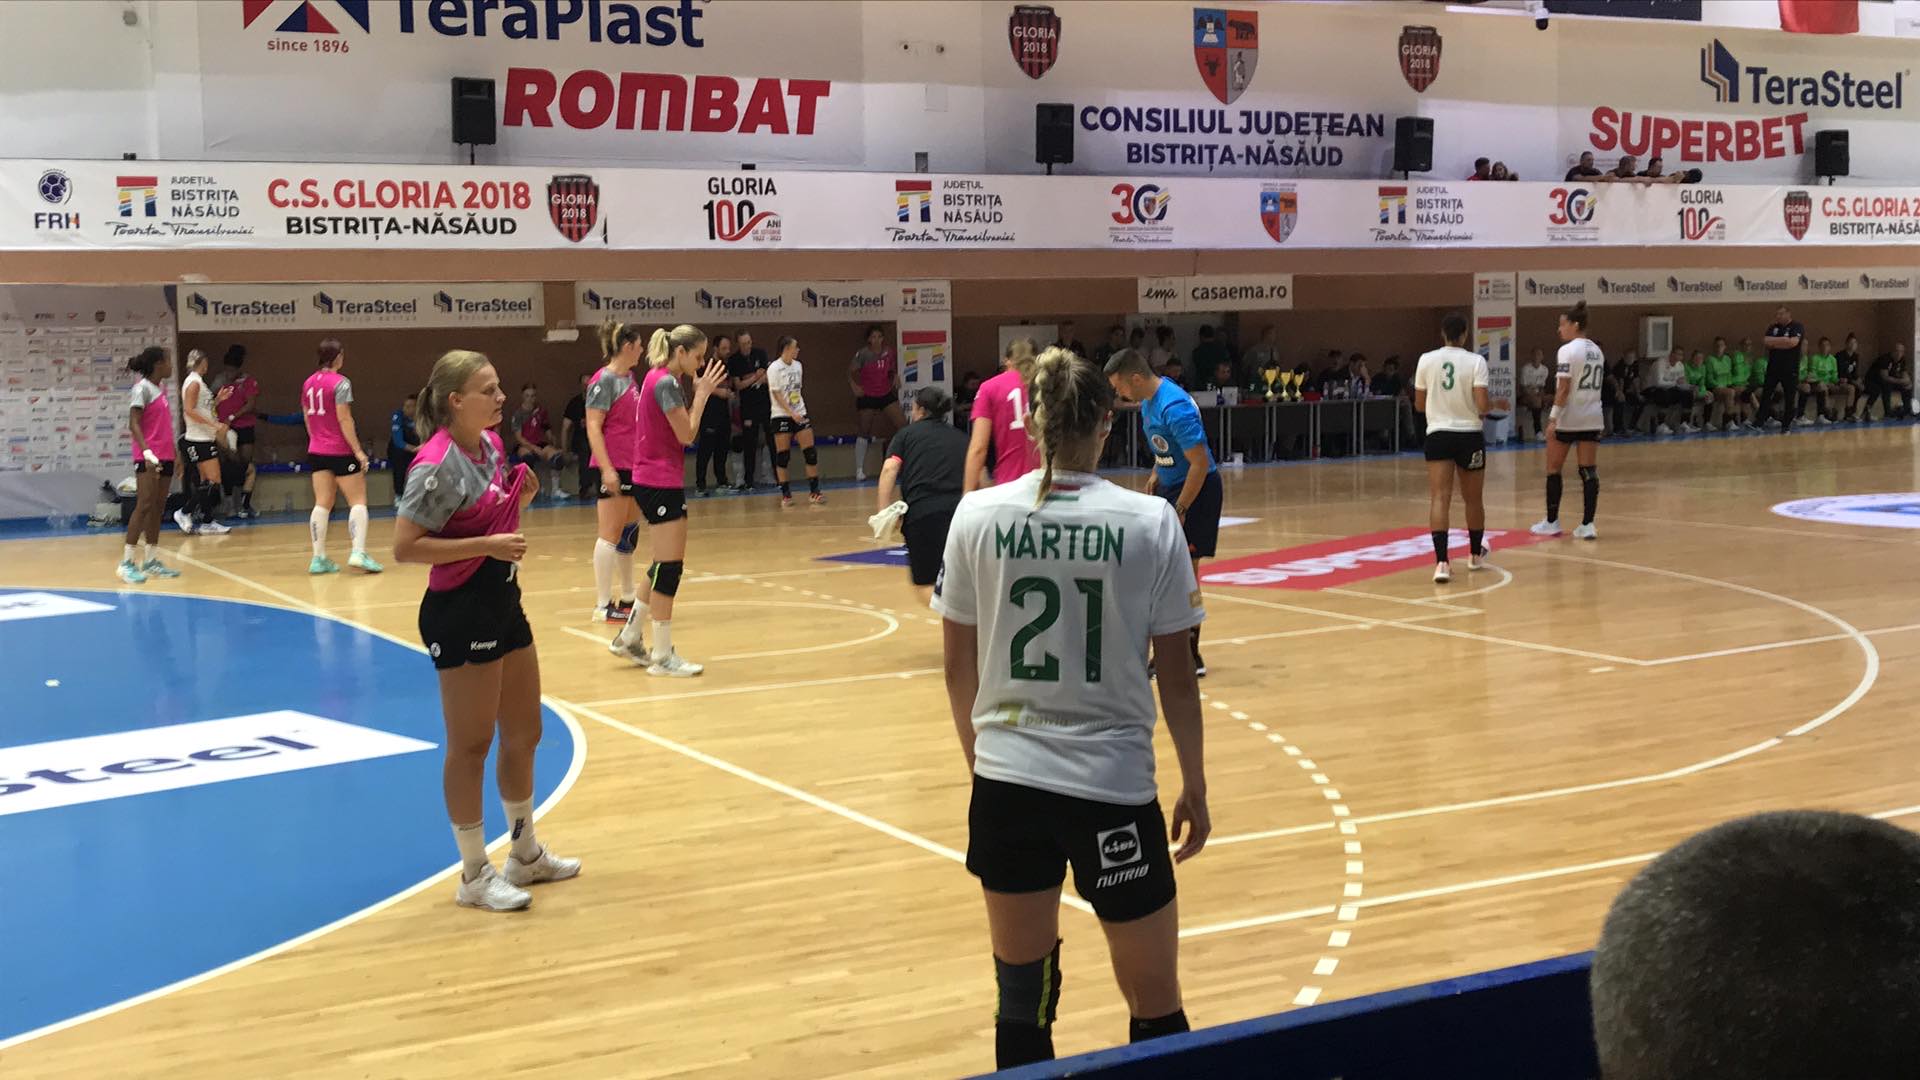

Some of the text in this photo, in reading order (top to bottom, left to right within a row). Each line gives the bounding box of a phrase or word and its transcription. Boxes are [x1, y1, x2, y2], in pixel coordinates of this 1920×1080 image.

[1012, 26, 1057, 39] GLORIA
[267, 38, 350, 54] since 1896
[1023, 42, 1048, 54] 2018
[1401, 44, 1438, 56] GLORIA
[1409, 58, 1431, 69] 2018
[1745, 66, 1903, 109] TeraSteel
[503, 67, 831, 135] ROMBAT
[1080, 105, 1385, 143] CONSILIUL JUDEȚEAN
[1589, 106, 1808, 162] SUPERBET
[267, 178, 532, 209] C.S. GLORIA 2018
[707, 176, 777, 196] GLORIA
[551, 193, 596, 205] GLORIA
[1680, 189, 1724, 204] GLORIA
[562, 207, 587, 218] 2018
[1822, 196, 1851, 217] C.S.
[1852, 196, 1910, 217] GLORIA
[34, 212, 80, 229] FRH
[703, 199, 755, 241] 100
[1677, 207, 1710, 240] 100
[1539, 282, 1585, 295] TeraSteel
[1610, 282, 1656, 293] TeraSteel
[1679, 280, 1723, 292] TeraSteel
[1746, 279, 1788, 291] TeraSteel
[1809, 278, 1850, 289] TeraSteel
[1870, 277, 1910, 289] TeraSteel
[1191, 285, 1288, 300] casaema.ro
[211, 299, 296, 315] TeraSteel
[336, 298, 417, 314] TeraSteel
[455, 297, 532, 312] TeraSteel
[603, 296, 675, 310] TeraSteel
[714, 294, 783, 310] TeraSteel
[820, 294, 884, 308] TeraSteel
[1441, 361, 1455, 390] 3
[1577, 364, 1603, 390] 20
[306, 387, 326, 415] 11
[1010, 576, 1103, 682] 21
